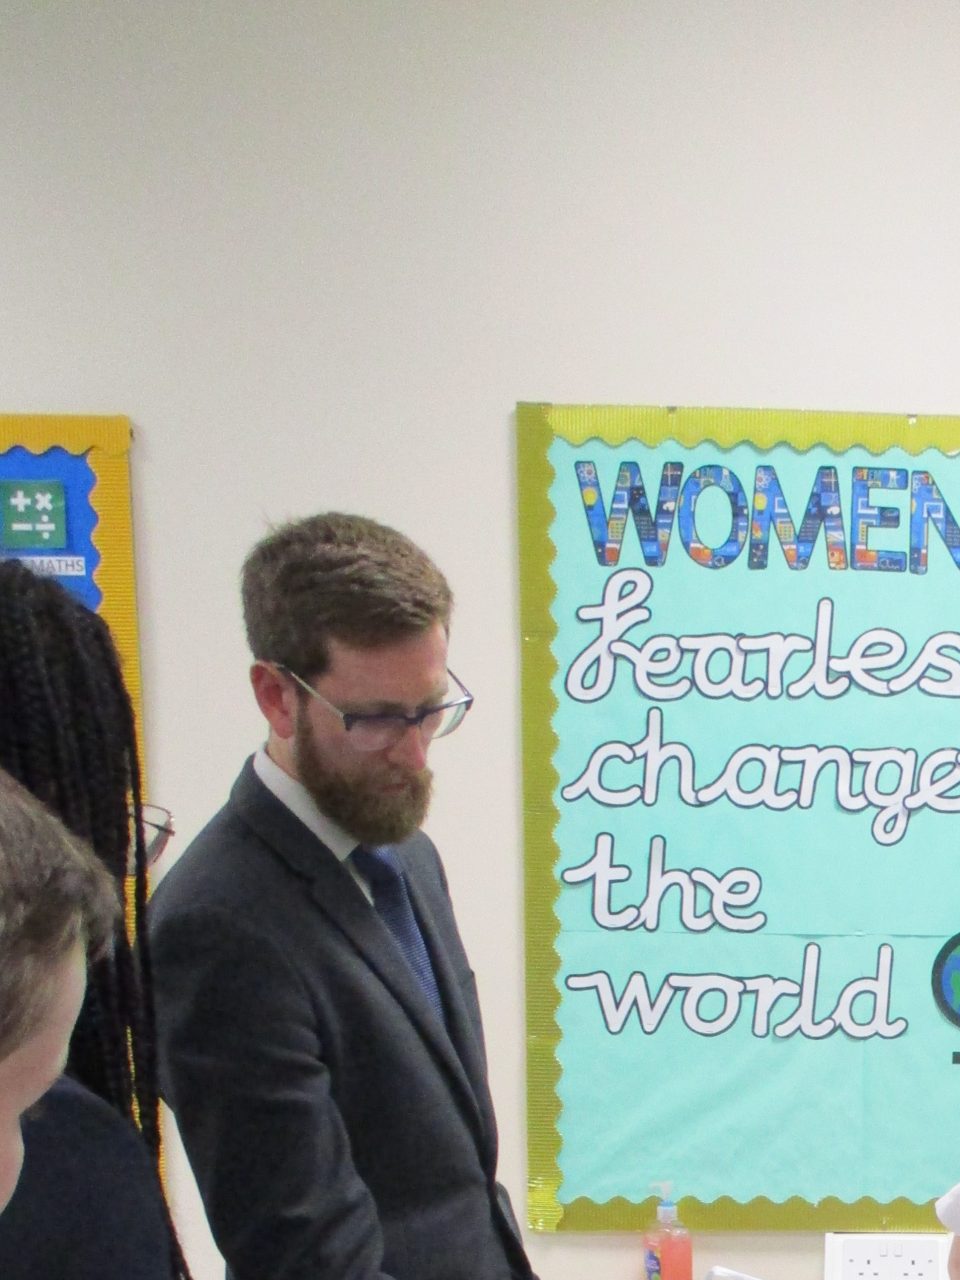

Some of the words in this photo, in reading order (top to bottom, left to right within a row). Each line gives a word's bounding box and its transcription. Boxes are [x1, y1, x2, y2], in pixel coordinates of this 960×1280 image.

[32, 558, 84, 573] MATHS
[561, 833, 766, 932] the
[564, 941, 907, 1040] world
